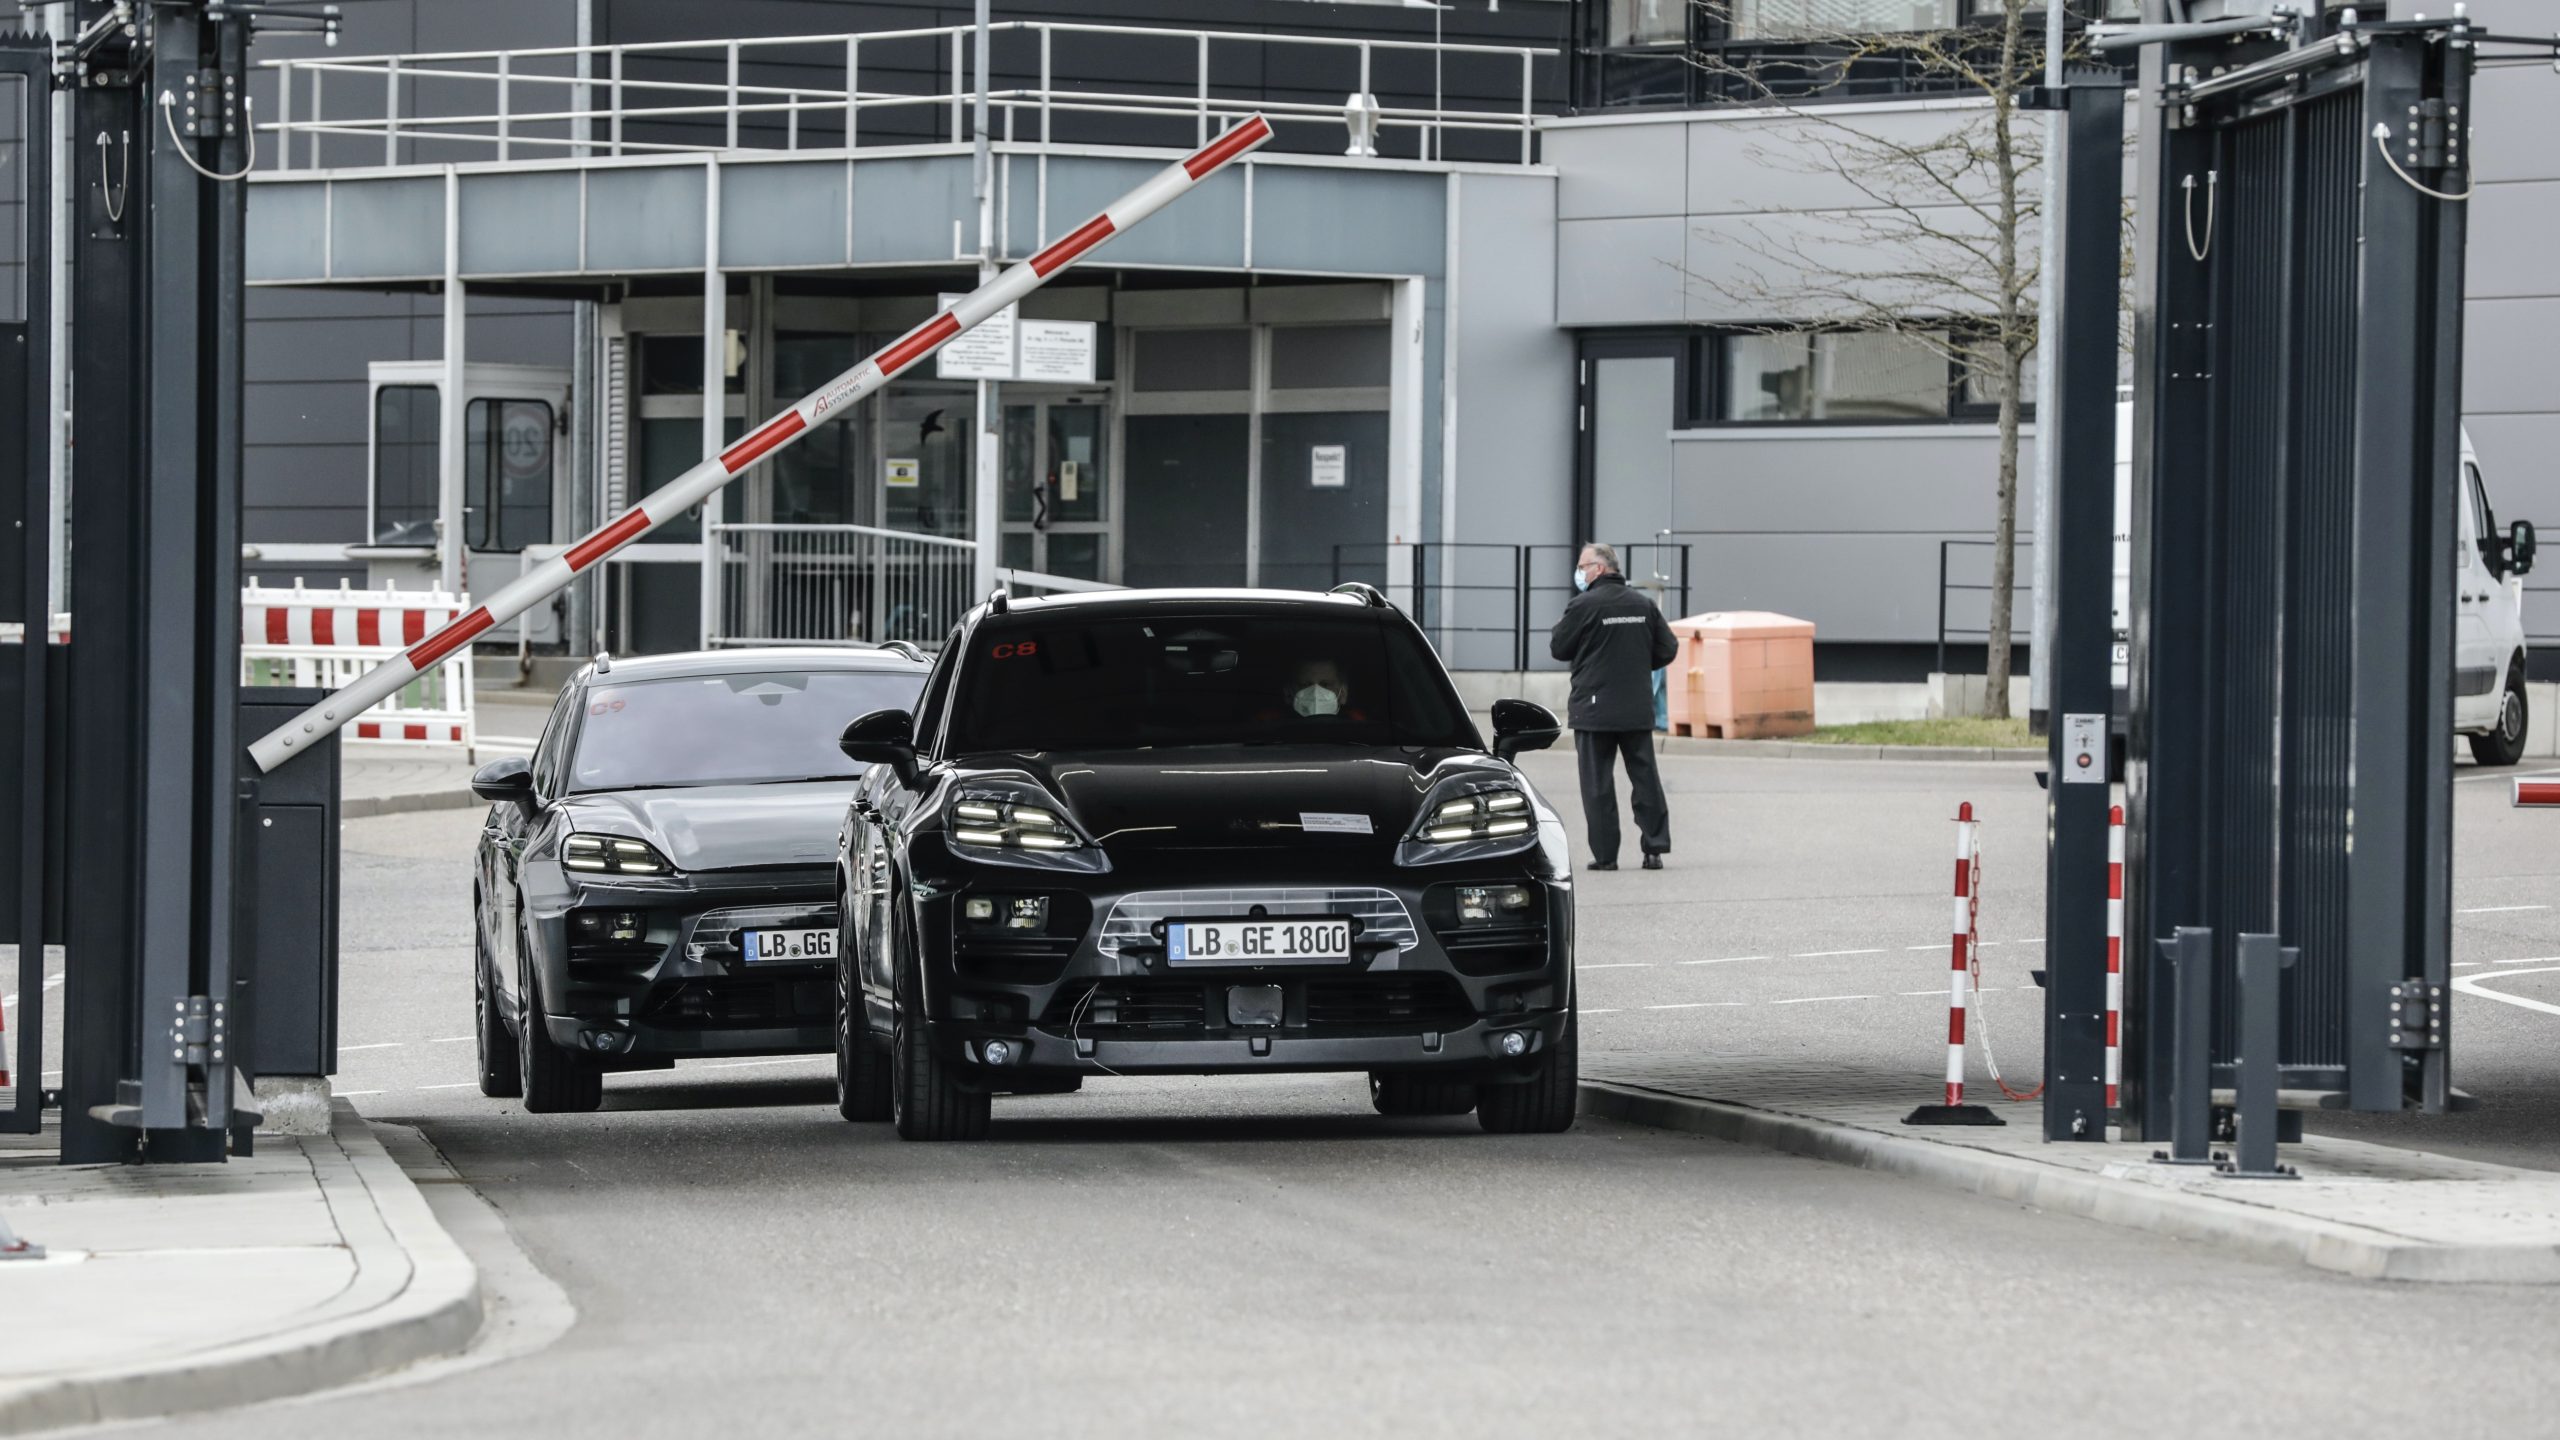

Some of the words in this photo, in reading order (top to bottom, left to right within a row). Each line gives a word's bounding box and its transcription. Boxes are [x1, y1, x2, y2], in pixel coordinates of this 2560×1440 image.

[826, 367, 871, 398] AUTOMATIC
[828, 384, 862, 409] SYSTEMS
[991, 641, 1038, 659] C8
[590, 700, 626, 716] C9
[748, 949, 754, 957] D
[758, 933, 786, 957] LB
[803, 931, 831, 955] GG
[1187, 927, 1221, 956] LB
[1242, 926, 1275, 955] GE
[1282, 925, 1347, 954] 1800
